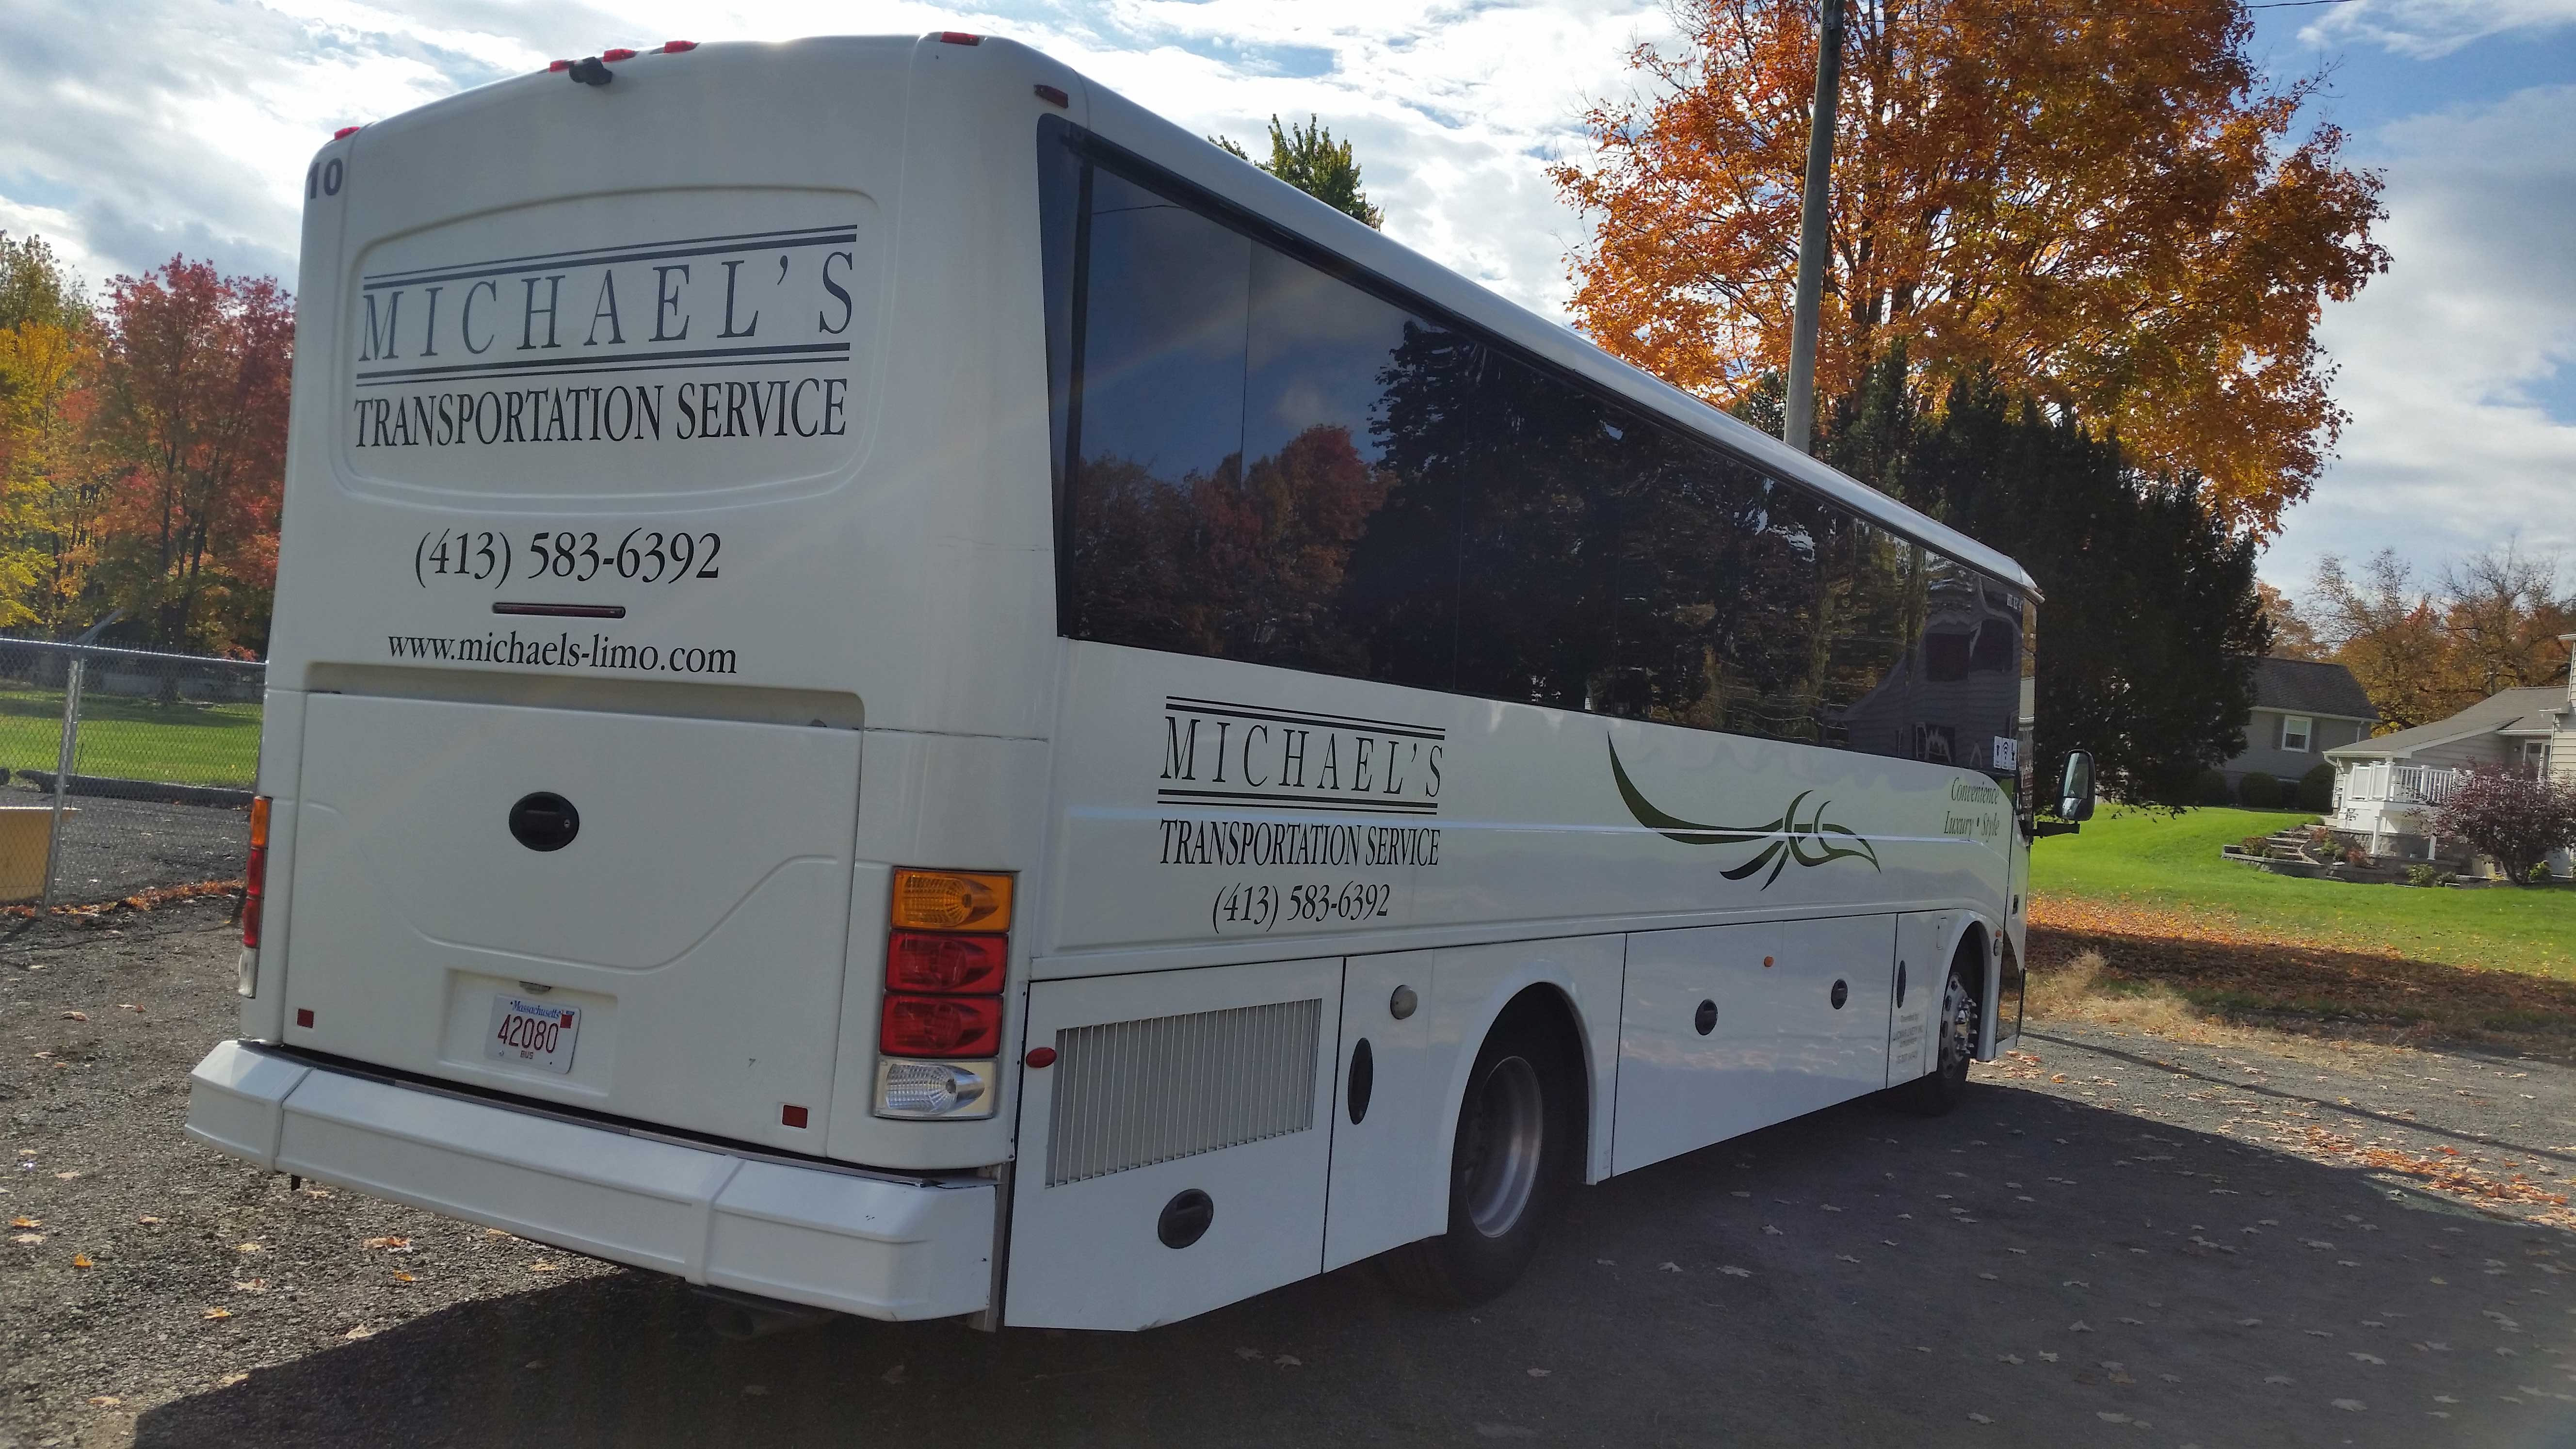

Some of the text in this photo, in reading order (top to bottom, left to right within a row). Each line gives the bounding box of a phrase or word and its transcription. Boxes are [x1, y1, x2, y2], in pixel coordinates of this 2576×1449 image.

[307, 158, 343, 199] 10
[358, 251, 854, 362] MICHAEL'S
[354, 377, 848, 448] TRANSPORTATION SERVICE
[415, 527, 722, 589] (413) 583-6392
[387, 631, 738, 674] www.michaels-limo.com
[1159, 716, 1443, 798] MICHAEL'S
[1951, 776, 1999, 805] Convenience
[1159, 818, 1441, 867] TRANSPORTATION SERVICE
[1943, 810, 2000, 843] Luxury Style
[1212, 881, 1390, 934] (413) 583-6392
[512, 1000, 560, 1019] Massachusetts
[498, 1014, 559, 1053] 42080
[520, 1050, 533, 1059] BUS
